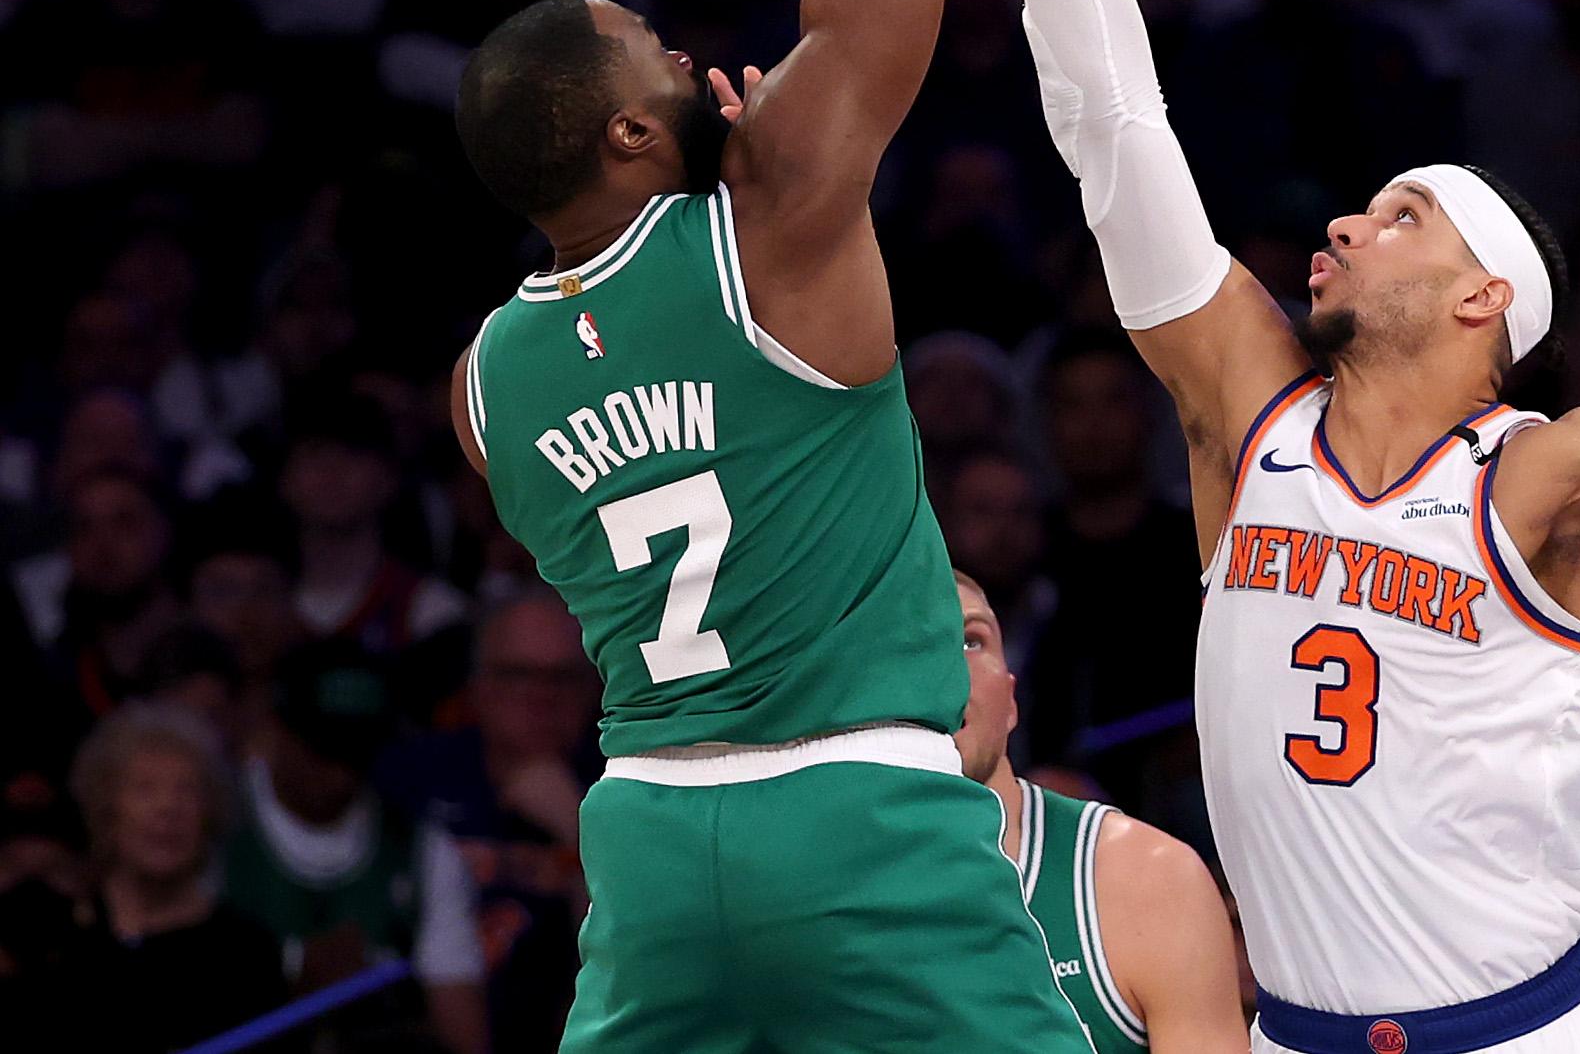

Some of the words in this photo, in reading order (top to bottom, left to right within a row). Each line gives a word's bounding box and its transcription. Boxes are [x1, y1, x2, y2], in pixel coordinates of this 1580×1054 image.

[534, 381, 716, 494] BROWN
[1401, 506, 1427, 519] abu
[1429, 503, 1470, 518] dhabi
[597, 470, 732, 684] 7
[1223, 524, 1334, 600] NEW
[1335, 538, 1489, 646] YORK
[1284, 623, 1380, 787] 3
